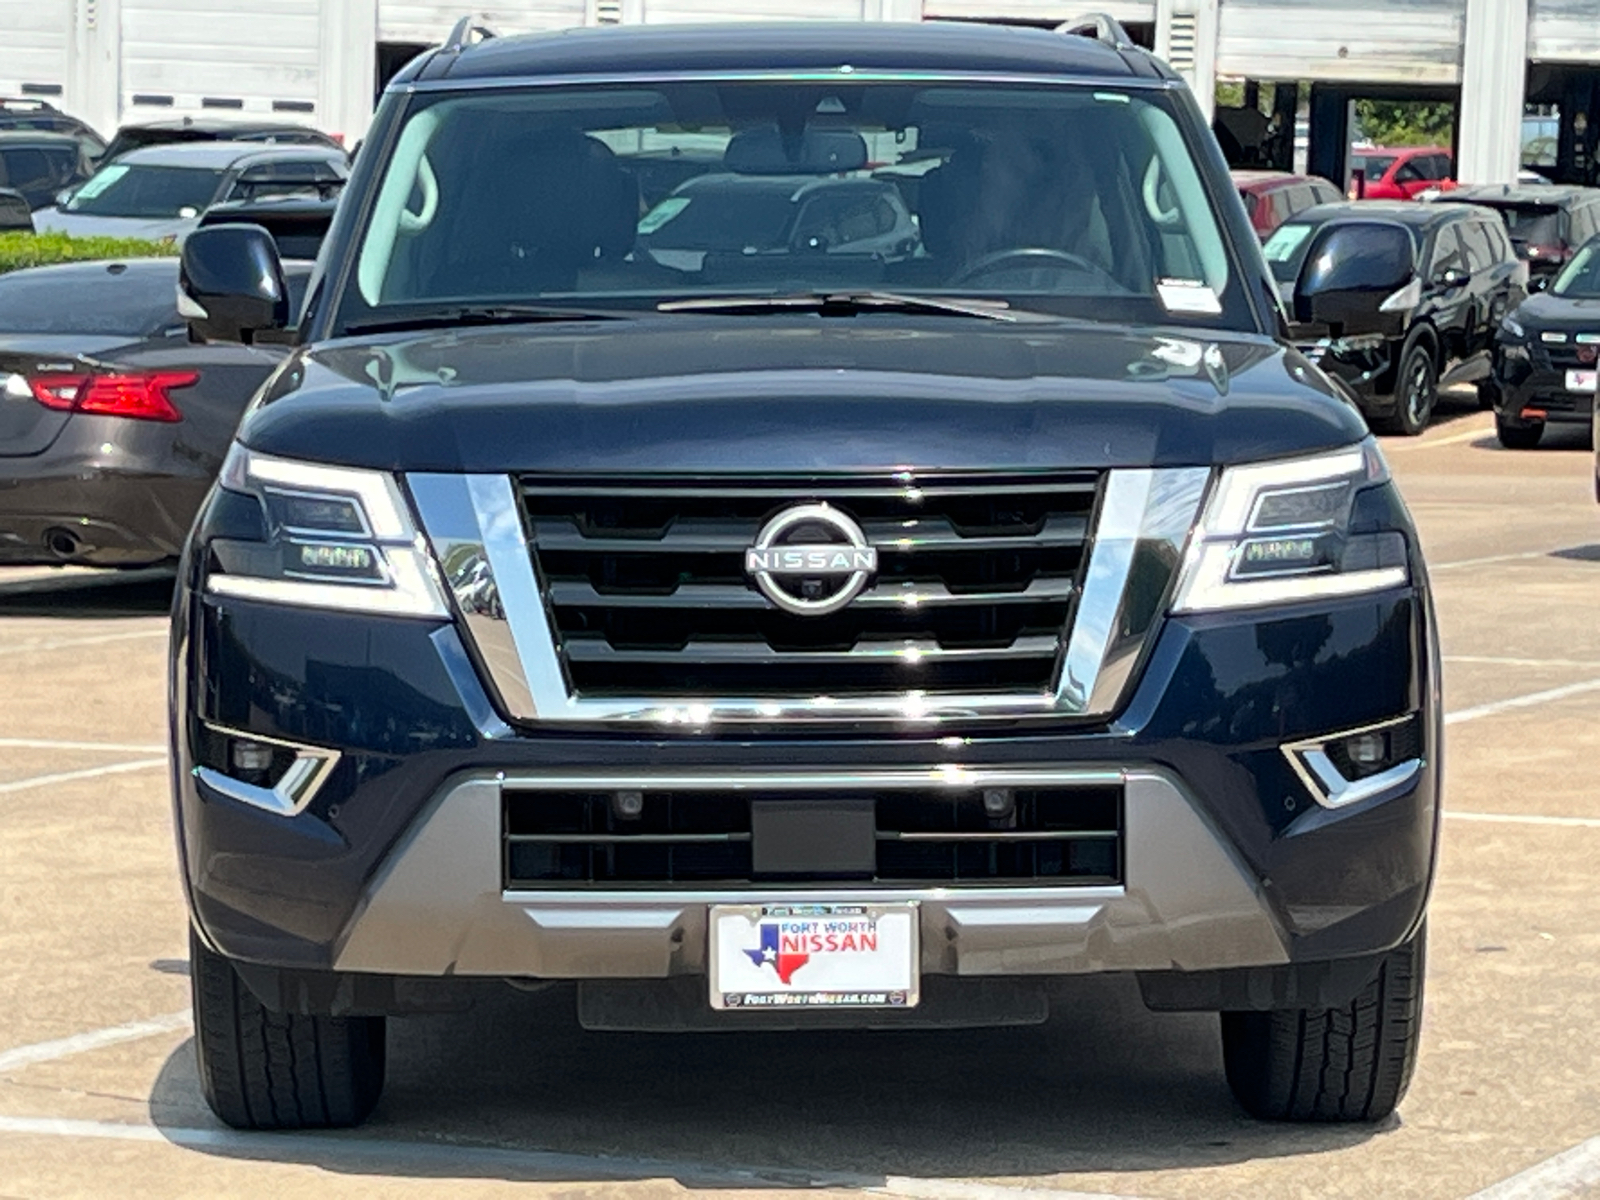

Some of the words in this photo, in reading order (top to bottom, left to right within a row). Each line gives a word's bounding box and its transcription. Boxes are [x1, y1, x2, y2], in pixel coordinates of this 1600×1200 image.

[749, 552, 873, 568] NISSAN
[781, 922, 819, 934] FORT
[825, 921, 877, 933] WORTH
[781, 934, 878, 952] NISSAN
